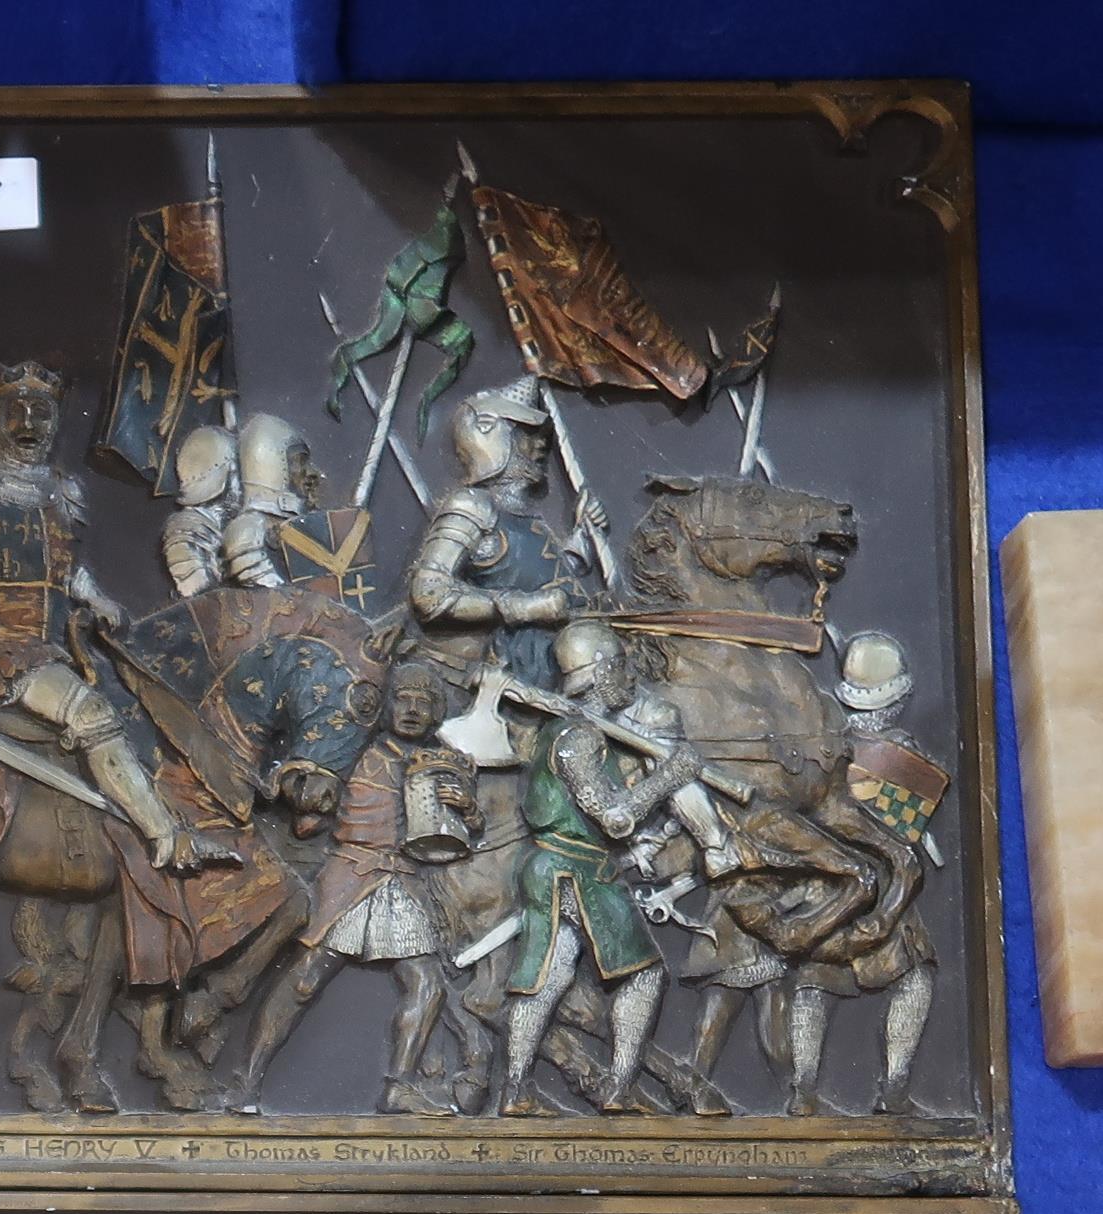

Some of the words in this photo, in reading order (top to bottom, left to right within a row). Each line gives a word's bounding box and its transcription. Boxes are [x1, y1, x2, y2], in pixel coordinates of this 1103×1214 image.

[24, 1140, 117, 1160] HENRY
[134, 1140, 157, 1158] V
[224, 1141, 321, 1161] Thomas
[512, 1144, 544, 1162] Sir
[552, 1143, 650, 1164] Thomas
